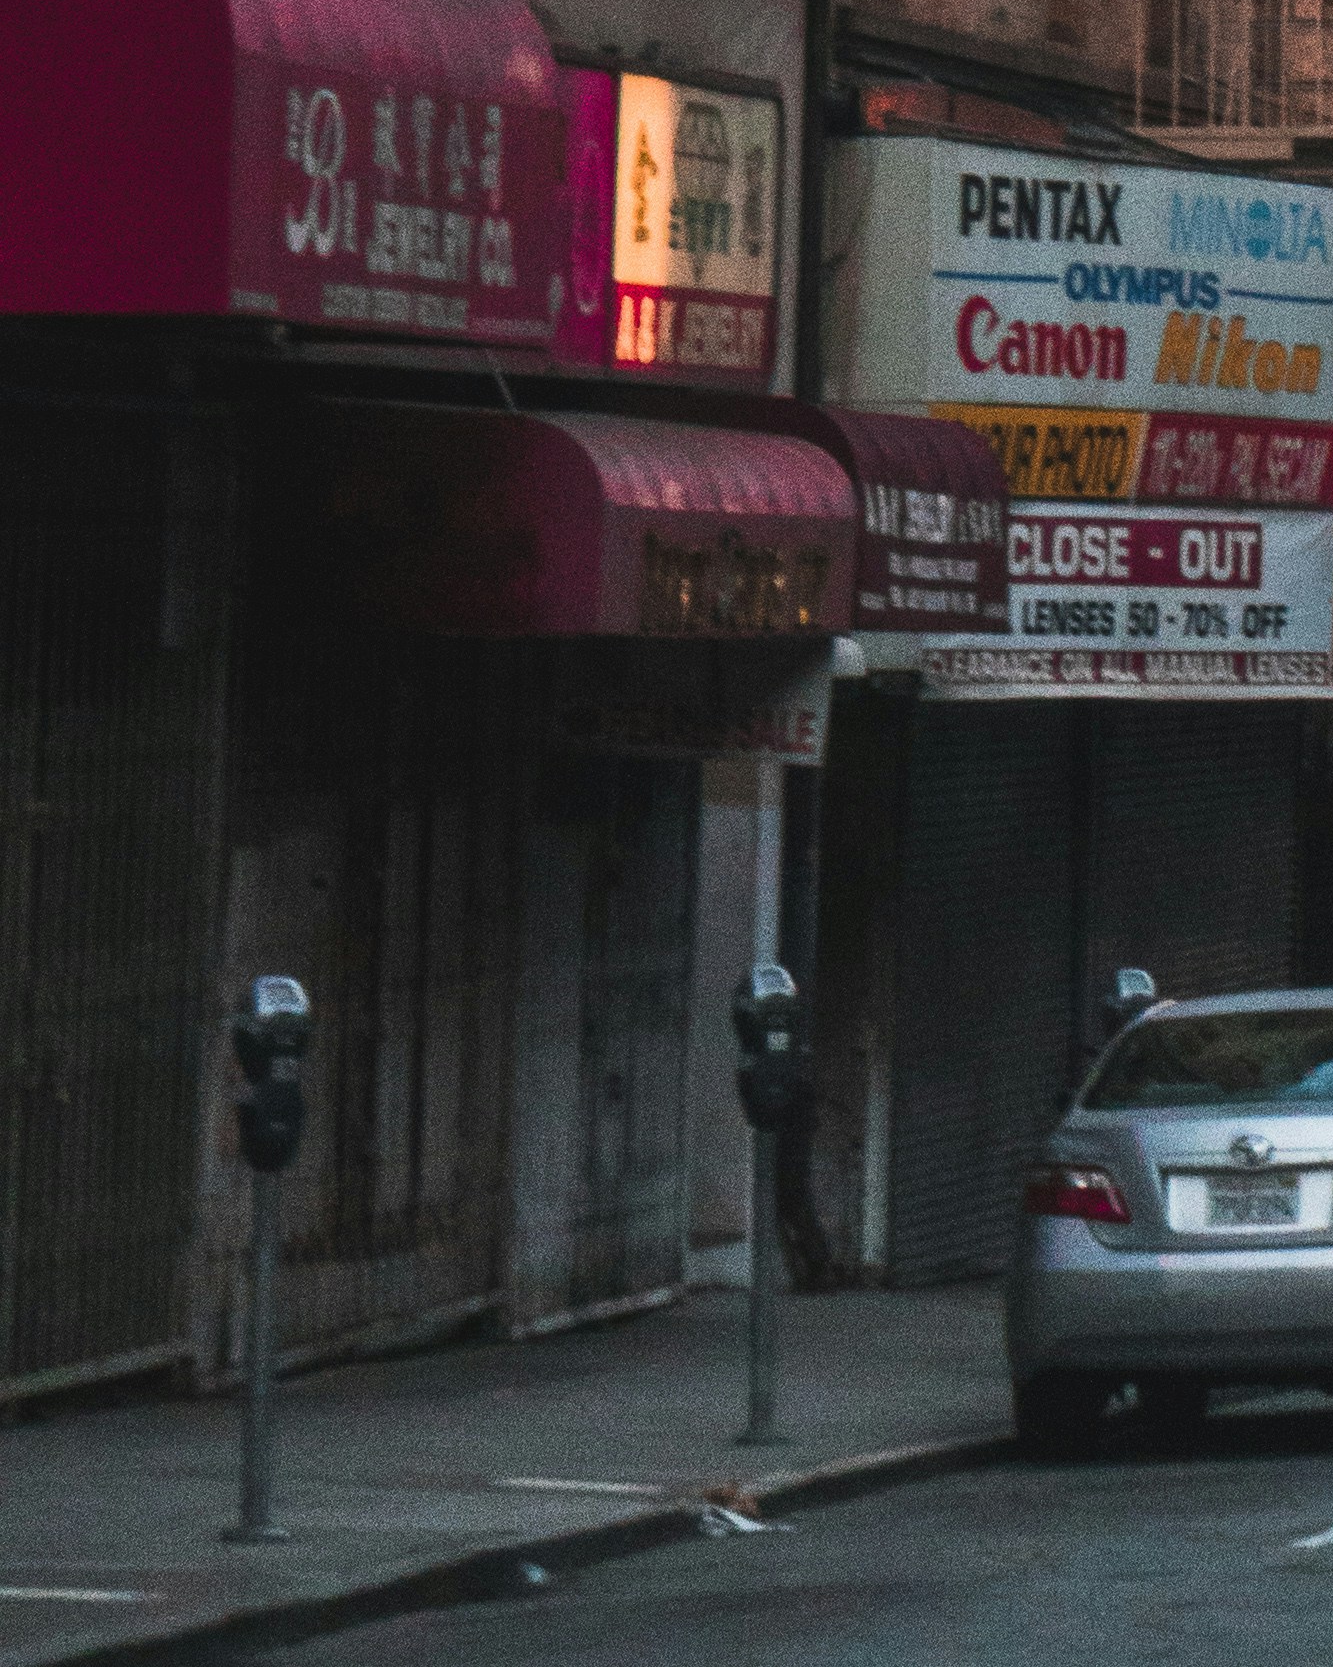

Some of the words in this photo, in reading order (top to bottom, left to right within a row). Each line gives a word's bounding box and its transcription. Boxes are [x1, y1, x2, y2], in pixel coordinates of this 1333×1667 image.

[959, 173, 1123, 246] PENTAX
[1170, 192, 1330, 265] MINOLTA
[1064, 263, 1222, 310] OLYMPUS
[956, 295, 1127, 381] Canon
[1152, 310, 1321, 394] Nikon
[1006, 522, 1131, 579] CLOSE
[1178, 527, 1259, 581] OUT
[1021, 598, 1117, 637] LENSES
[1126, 601, 1160, 638] 50
[1181, 602, 1230, 639] 70%
[1241, 603, 1291, 640] OFF
[930, 651, 1054, 683] CLEARANCE
[1059, 651, 1094, 683] ON
[1100, 652, 1140, 683] ALL
[1144, 652, 1239, 684] MANUAL
[1245, 652, 1329, 685] LENSES
